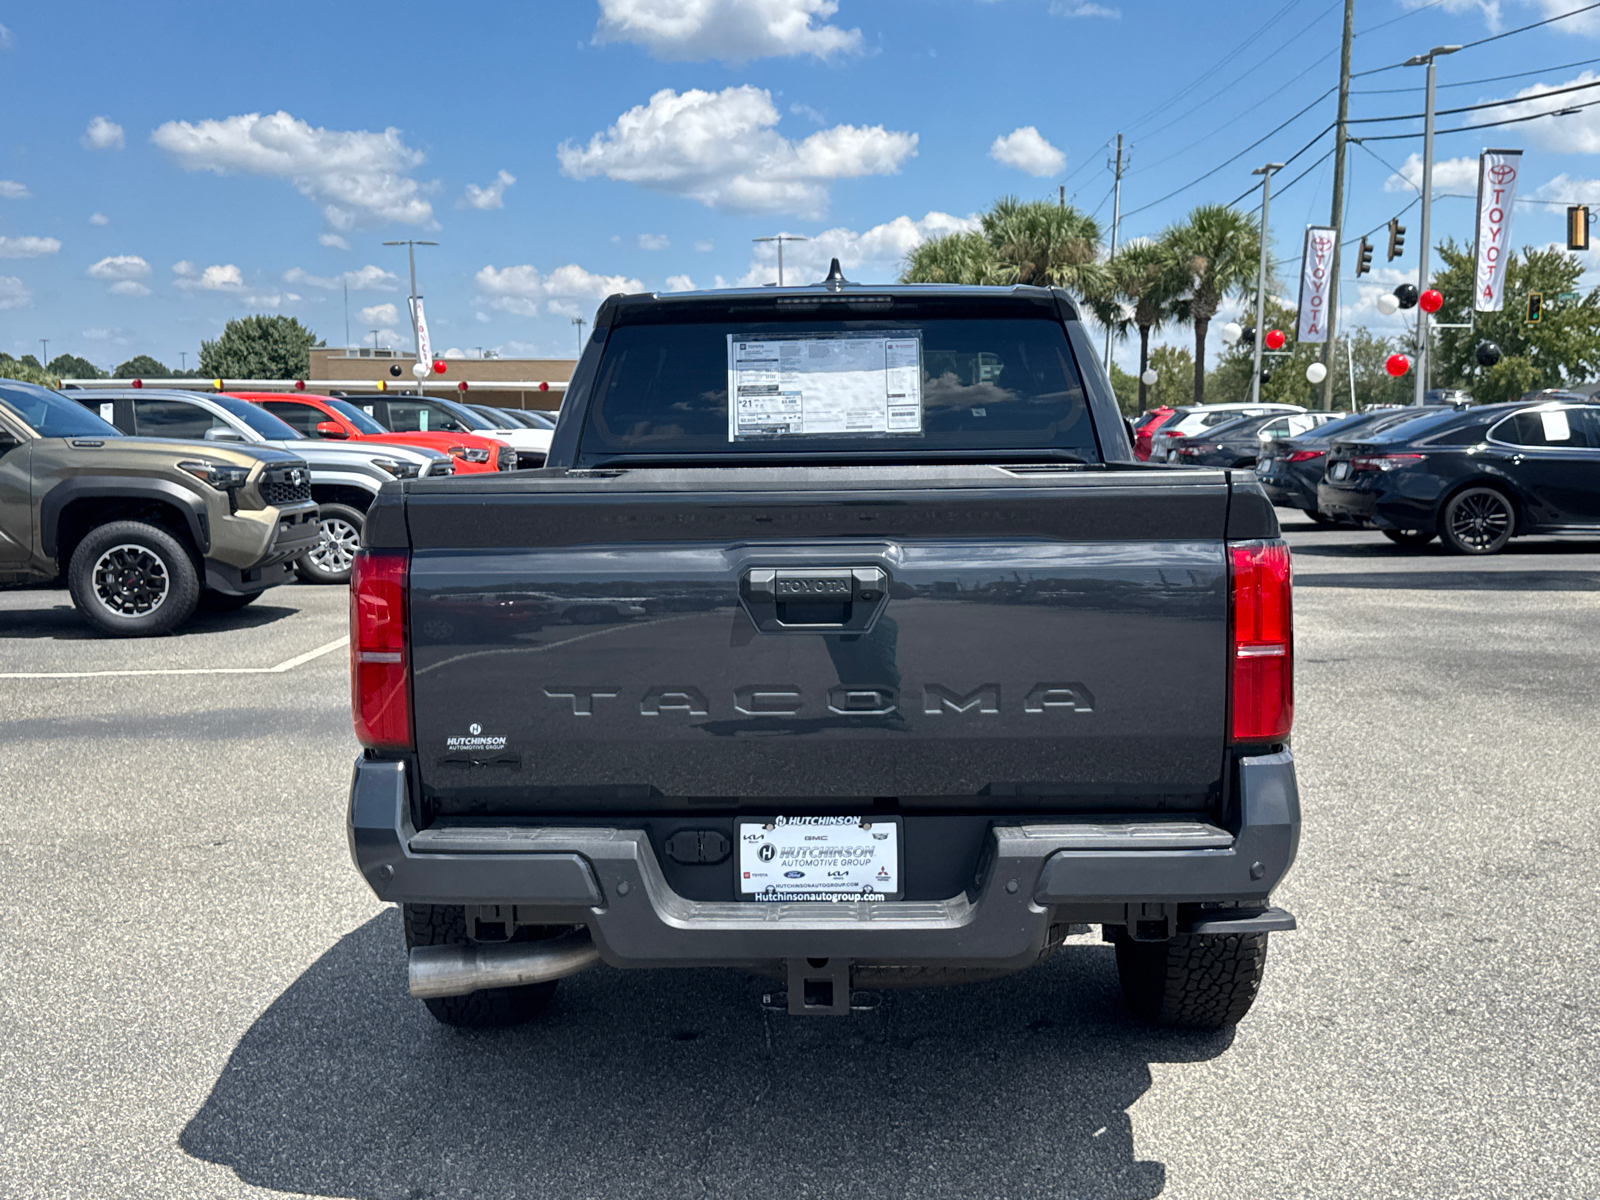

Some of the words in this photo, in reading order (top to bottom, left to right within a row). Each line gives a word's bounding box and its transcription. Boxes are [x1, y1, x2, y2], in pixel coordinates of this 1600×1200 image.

[1481, 189, 1505, 300] TOYOTA
[1307, 254, 1326, 335] TOYOTA
[779, 579, 849, 593] TOYOTA
[543, 681, 1095, 716] TACOMA
[446, 737, 506, 745] HUTCHINSON
[788, 816, 861, 826] HUTCHINSON
[780, 846, 875, 858] HUTCHINSON
[781, 859, 838, 867] AUTOMOTIVE
[755, 892, 885, 903] Hutchinsonautogroup.com
